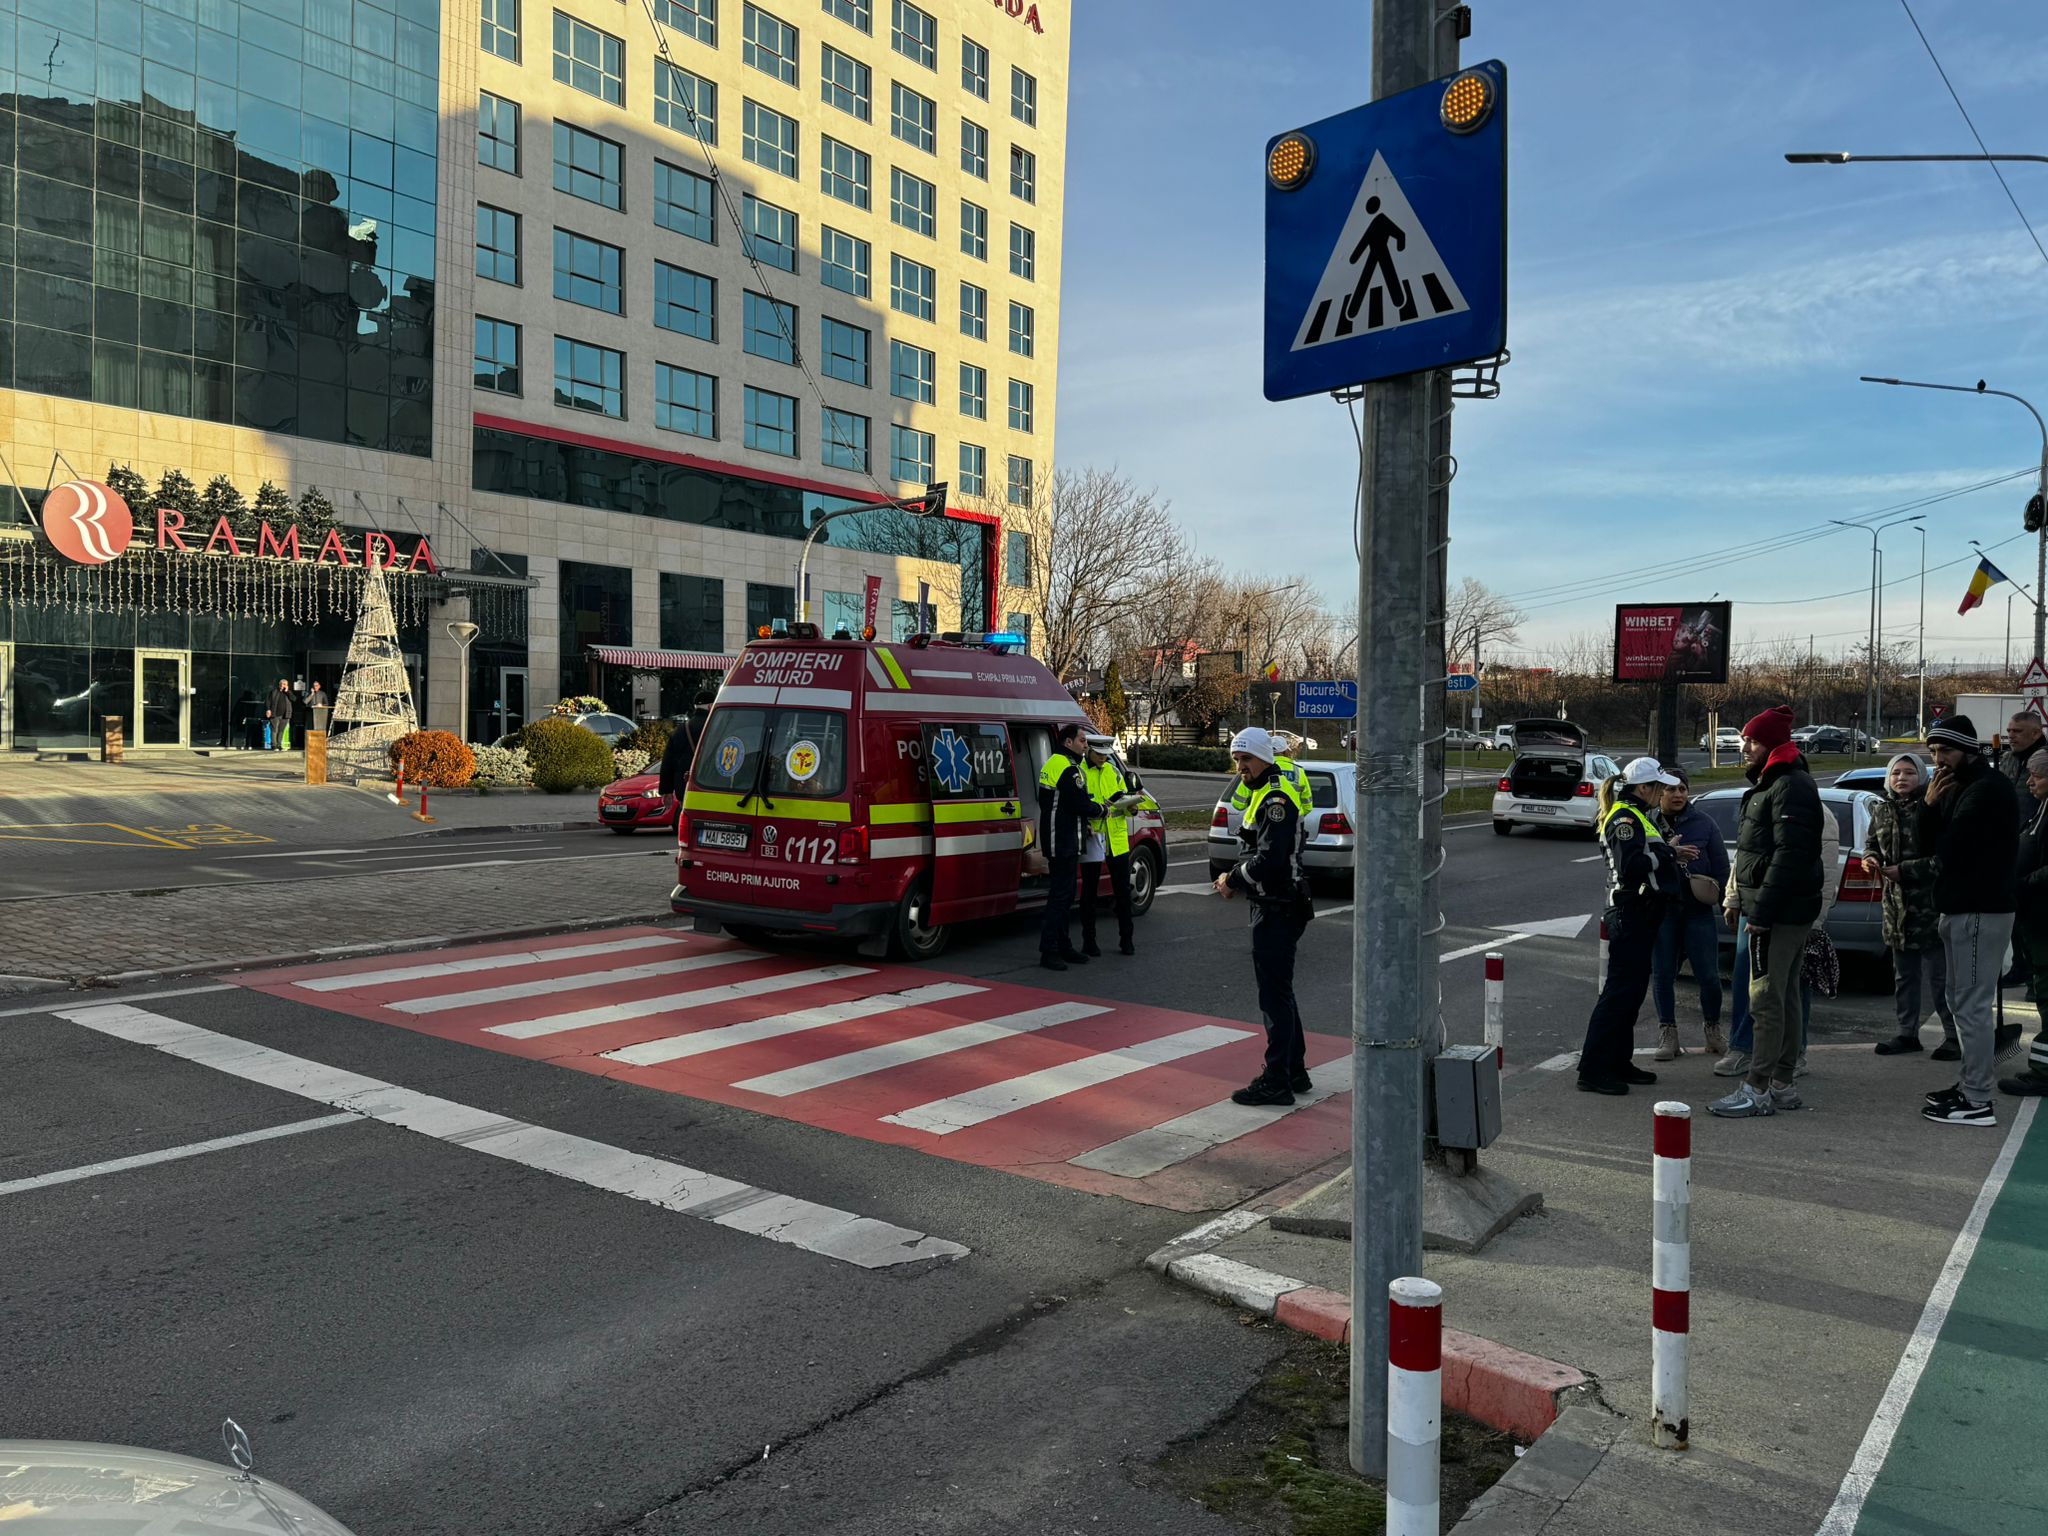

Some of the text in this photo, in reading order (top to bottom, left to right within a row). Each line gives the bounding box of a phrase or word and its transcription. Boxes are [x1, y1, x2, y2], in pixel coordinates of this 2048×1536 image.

[157, 508, 436, 574] RAMADA
[868, 587, 879, 624] RAMA
[1624, 616, 1675, 627] WINBET
[740, 651, 844, 671] POMPIERII
[753, 669, 814, 685] SMURD
[976, 671, 1038, 685] ECHIPAJ PRIM AJUTOR
[1447, 675, 1467, 690] ești
[720, 834, 745, 847] 58951
[764, 846, 774, 856] B2
[795, 836, 837, 865] 112
[706, 870, 800, 890] ECHIPAJ PRIM AJUTOR
